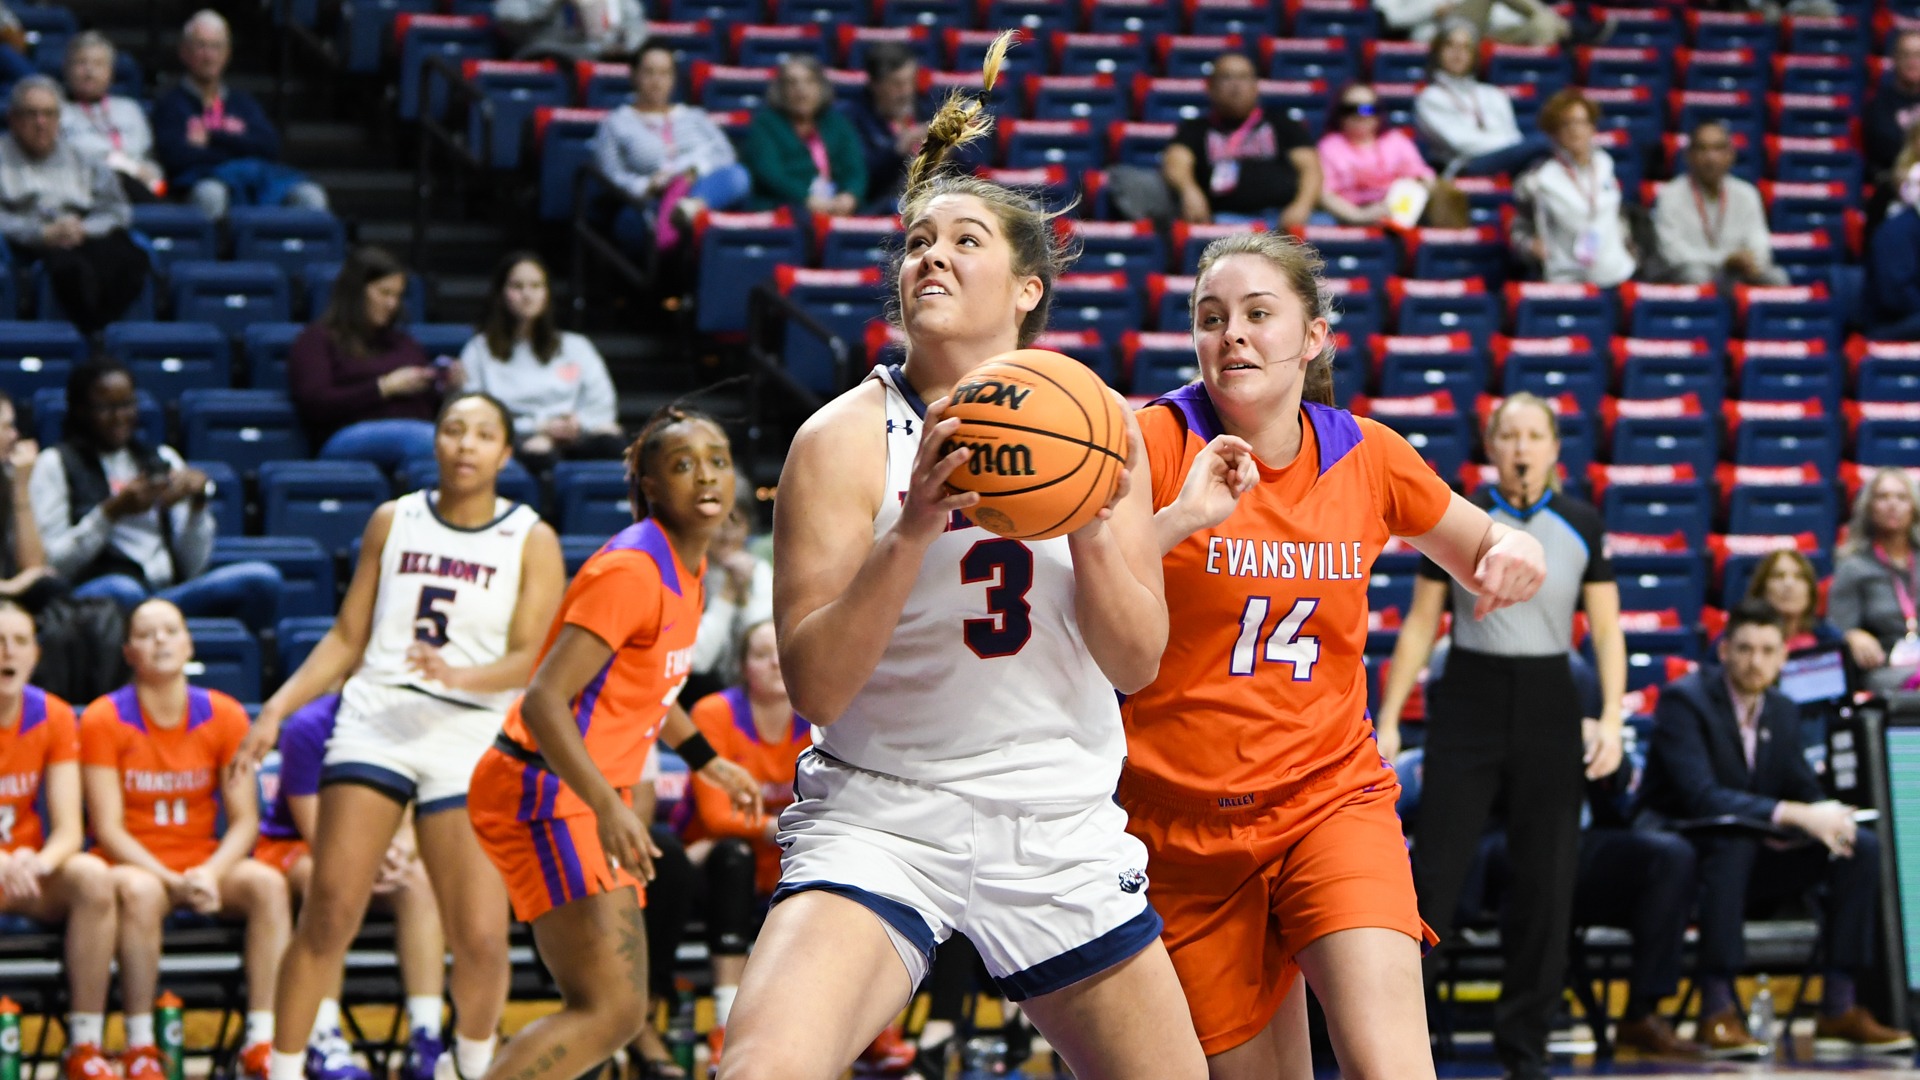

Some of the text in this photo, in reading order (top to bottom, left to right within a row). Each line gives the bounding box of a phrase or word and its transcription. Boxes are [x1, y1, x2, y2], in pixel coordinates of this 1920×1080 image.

[1206, 535, 1364, 580] EVANSVILLE
[415, 585, 457, 649] 5
[960, 537, 1033, 660] 3
[1229, 595, 1322, 682] 14
[1217, 792, 1255, 808] VALLEY
